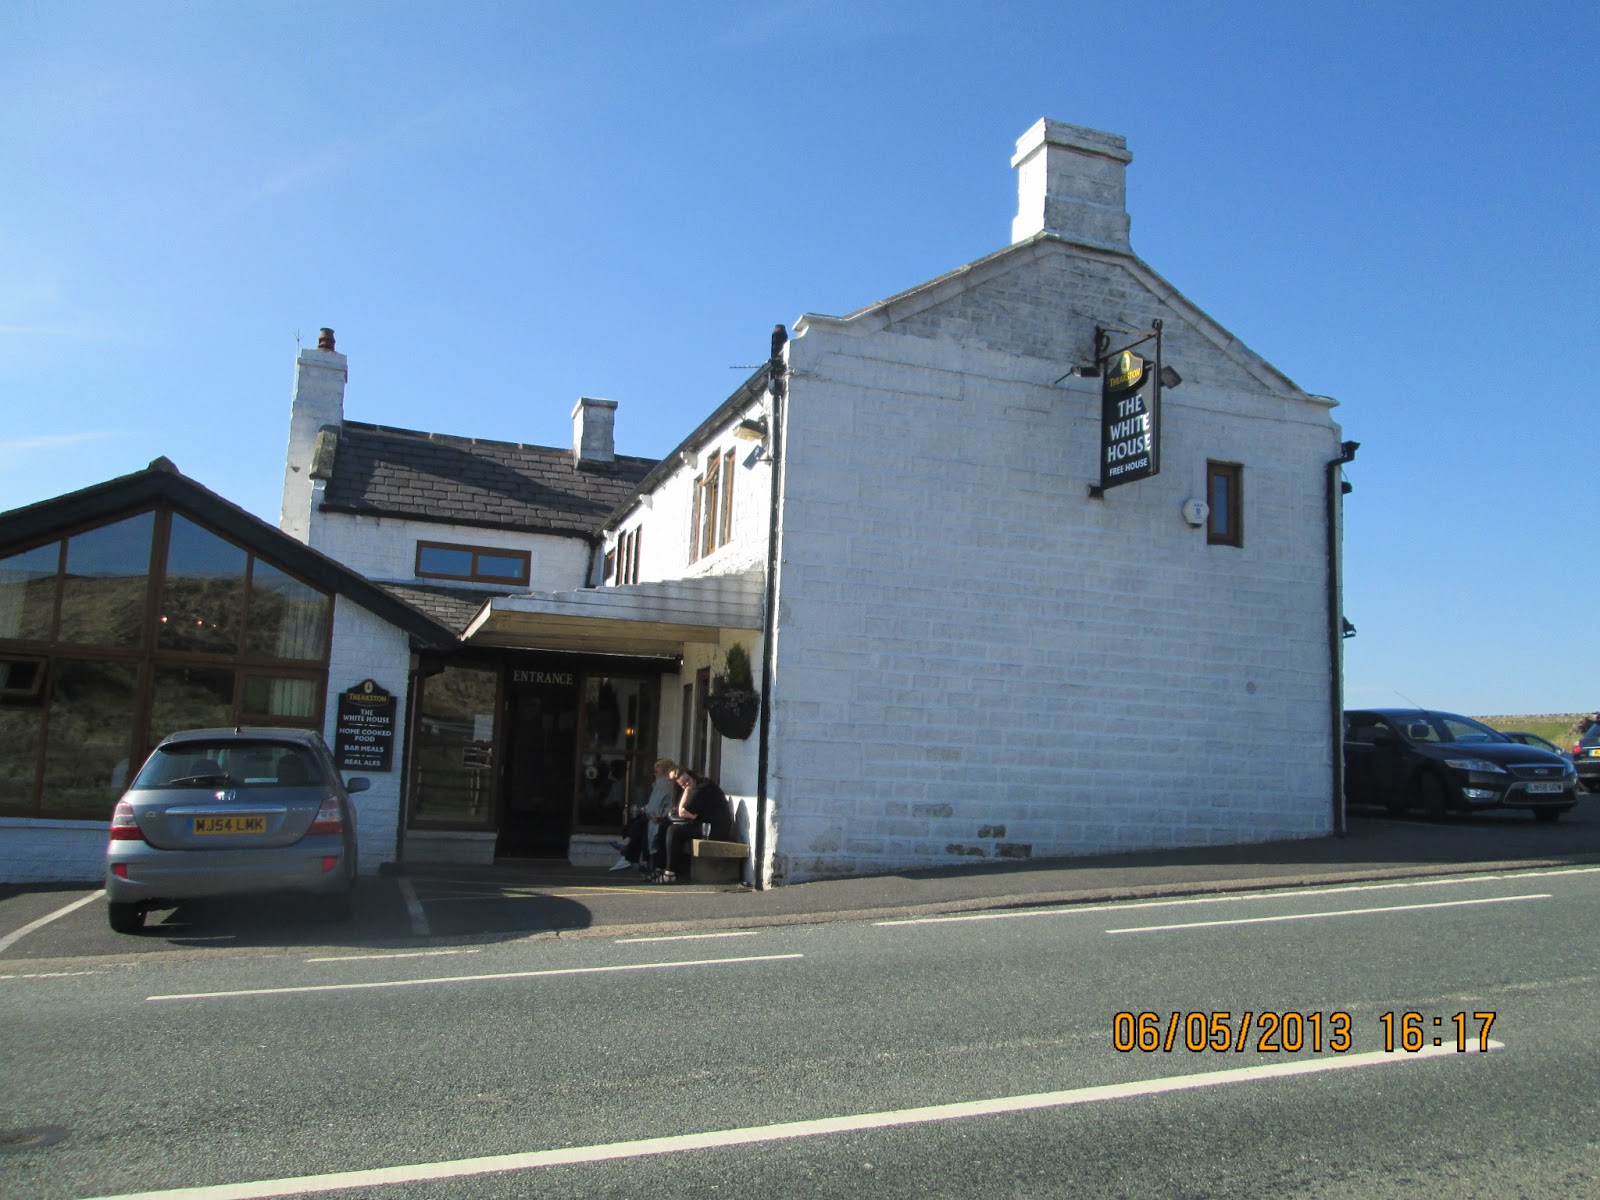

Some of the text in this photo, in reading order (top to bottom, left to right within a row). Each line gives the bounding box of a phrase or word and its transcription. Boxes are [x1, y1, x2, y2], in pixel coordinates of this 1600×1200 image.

[1118, 394, 1142, 418] THE
[1110, 412, 1150, 441] WHITE
[1107, 432, 1151, 463] HOUSE
[1109, 458, 1148, 476] FREE HOUSE
[513, 670, 573, 685] ENTRANCE
[349, 693, 387, 702] THEAKSTON
[362, 729, 391, 737] COOKED
[196, 818, 263, 832] MJ54 LMK
